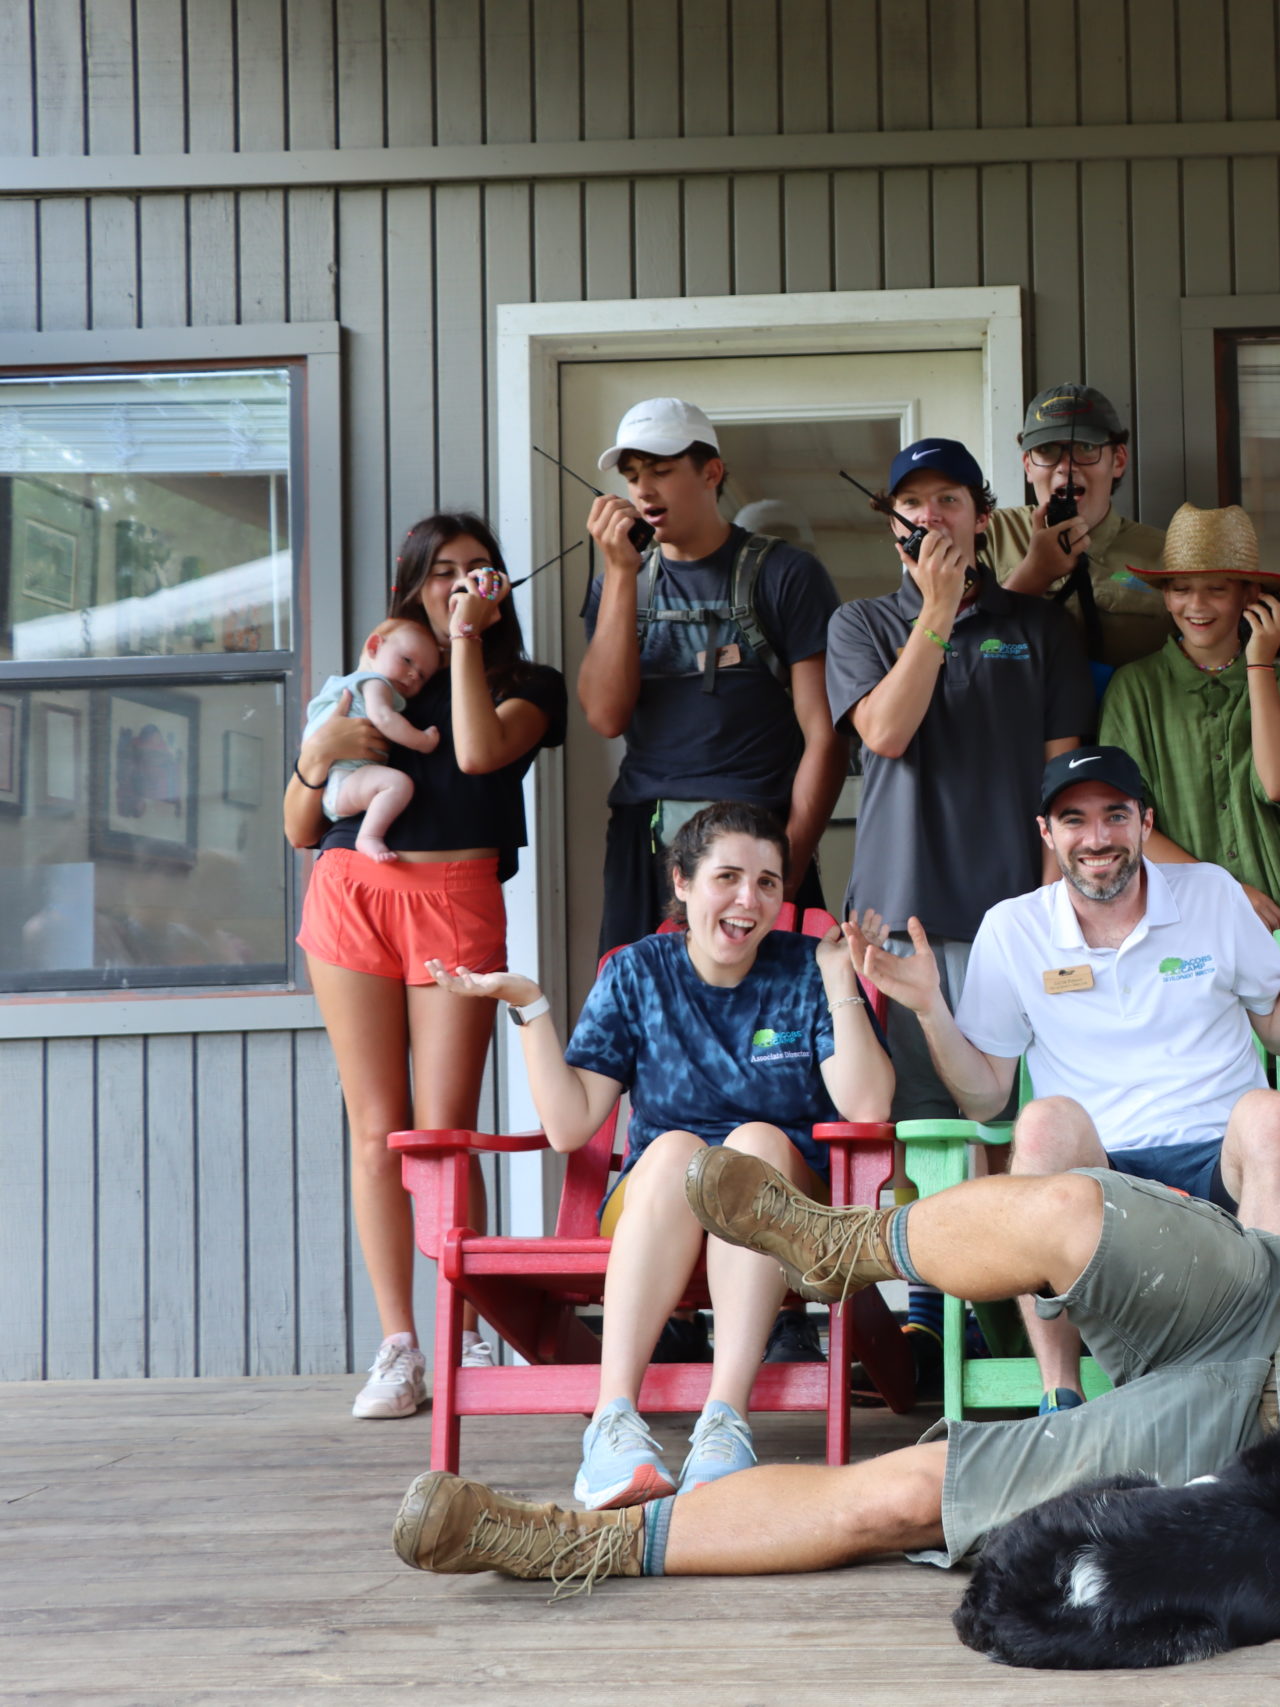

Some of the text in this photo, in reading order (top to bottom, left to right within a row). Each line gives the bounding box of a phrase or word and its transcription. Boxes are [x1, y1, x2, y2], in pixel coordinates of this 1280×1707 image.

[1181, 955, 1213, 968] JACOBS
[1181, 962, 1206, 973] CAMP
[750, 1050, 810, 1063] Associate Director
